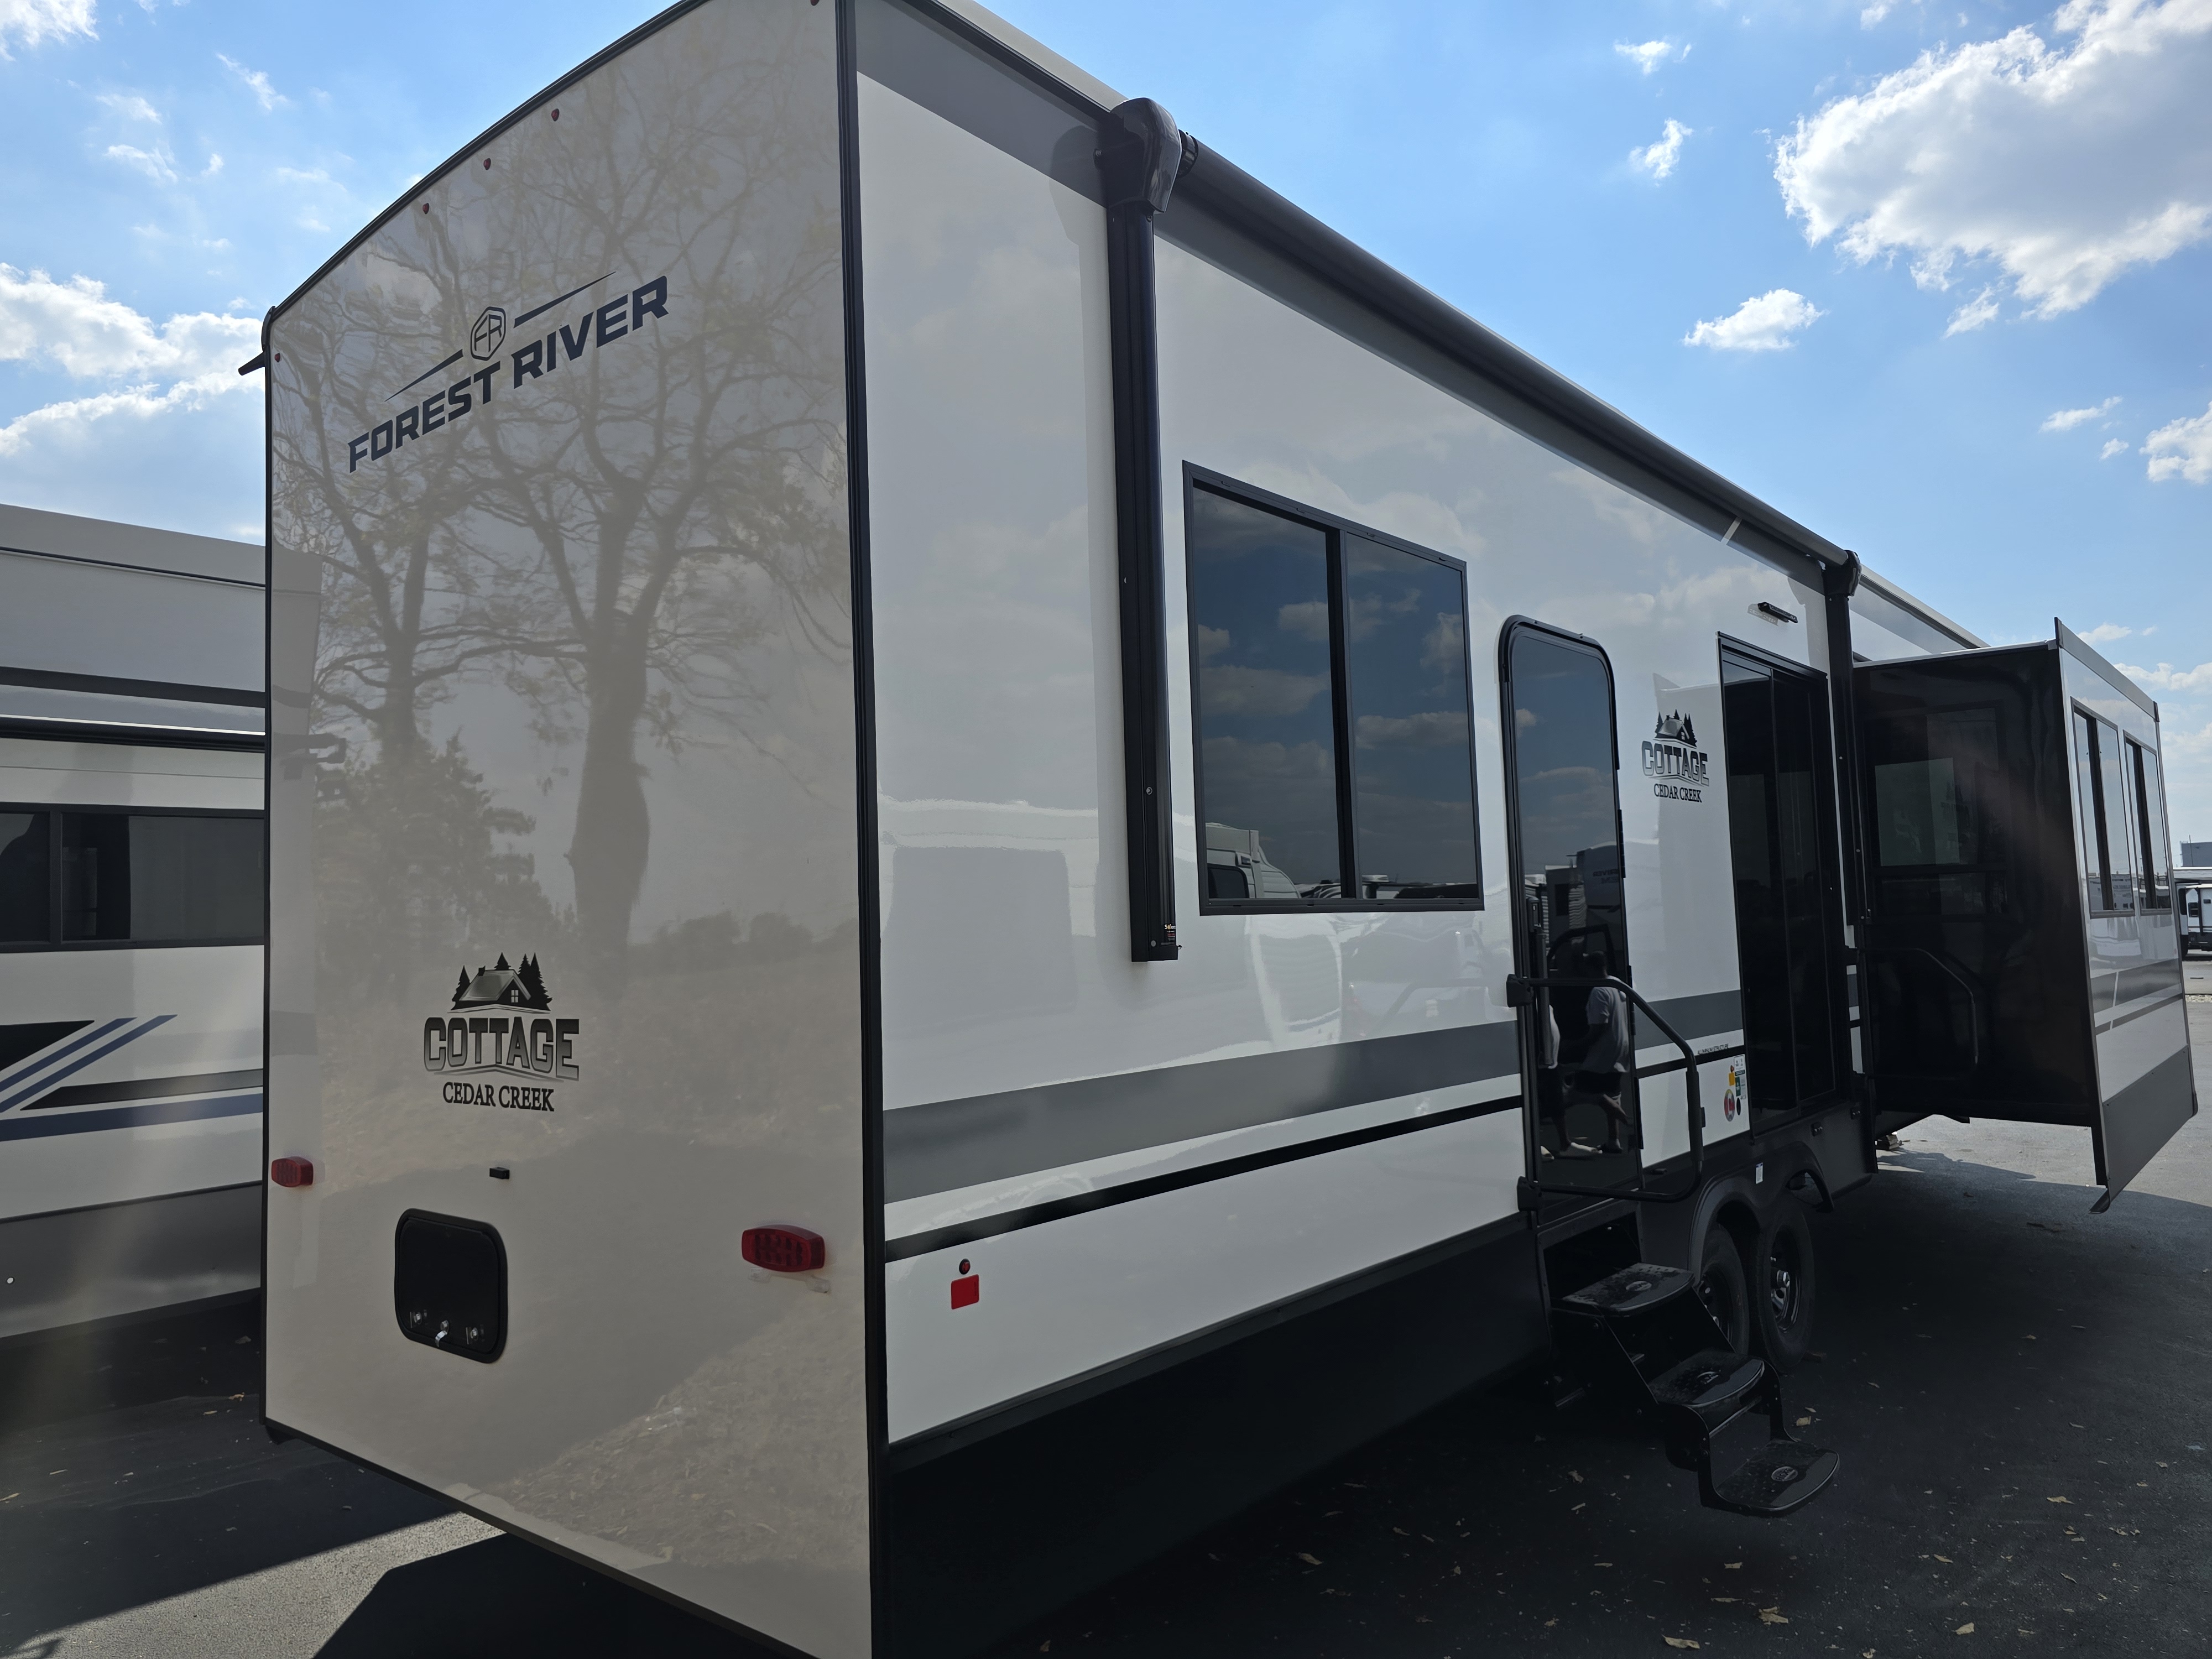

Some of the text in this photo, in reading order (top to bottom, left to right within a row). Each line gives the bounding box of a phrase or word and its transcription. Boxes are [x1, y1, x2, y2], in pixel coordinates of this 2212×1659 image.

[347, 275, 670, 473] FOREST RIVER
[1641, 740, 1710, 787] COTTAGE
[1653, 783, 1702, 803] CEDAR CREEK
[424, 1016, 580, 1081] COTTAGE
[442, 1081, 555, 1112] CEDAR CREEK
